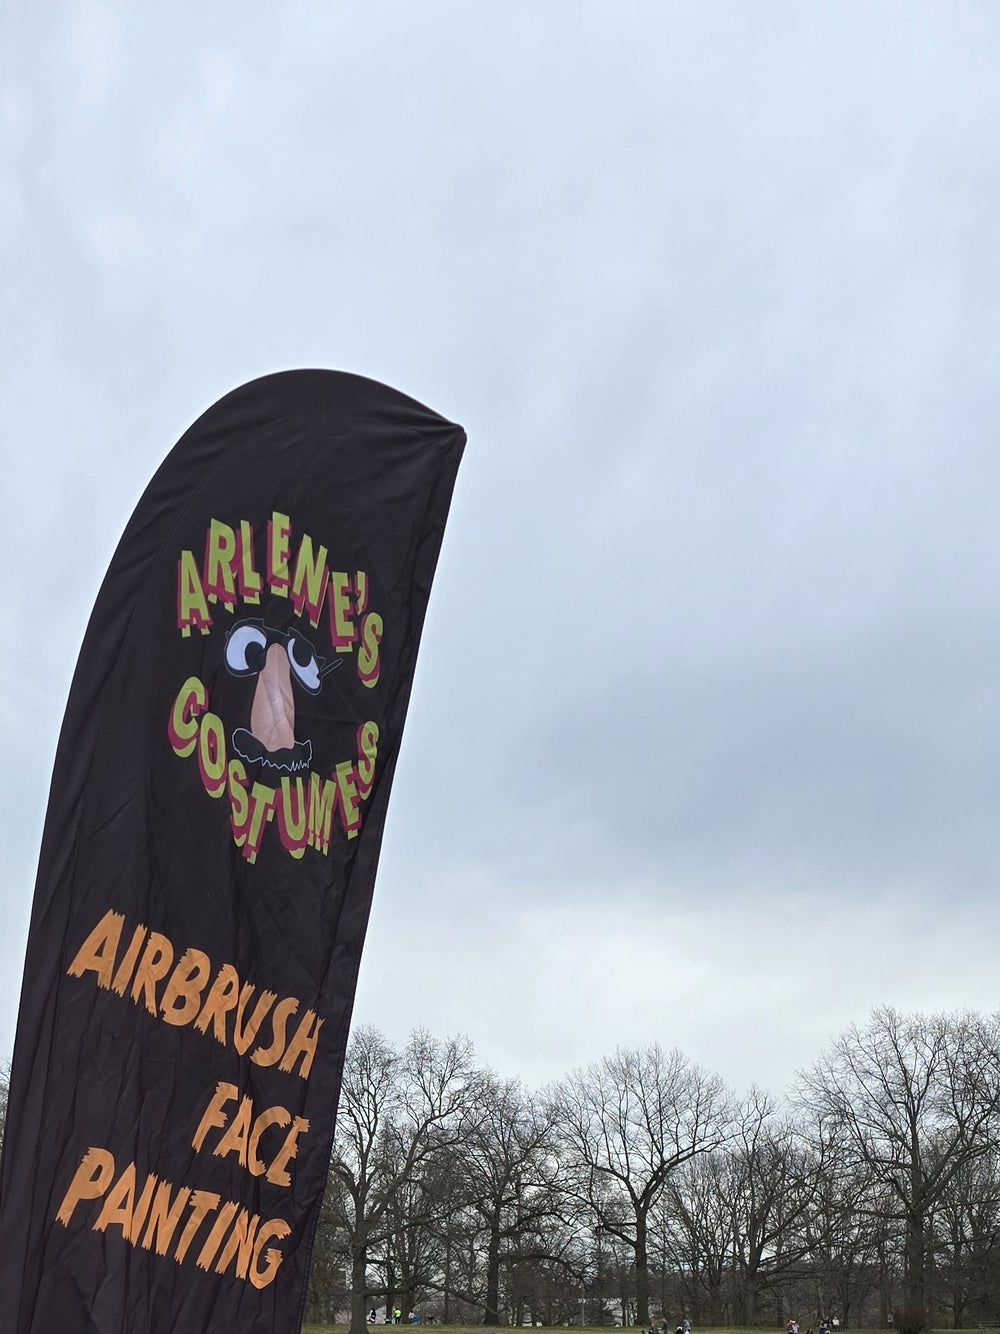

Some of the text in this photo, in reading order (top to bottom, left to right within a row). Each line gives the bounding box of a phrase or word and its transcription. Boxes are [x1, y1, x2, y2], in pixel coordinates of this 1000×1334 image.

[178, 511, 384, 688] ARLENE'S
[168, 676, 380, 865] COSTUMES
[67, 908, 325, 1080] AIRBRUSH
[55, 1146, 292, 1290] PAINTING
[191, 1081, 310, 1187] FACE
